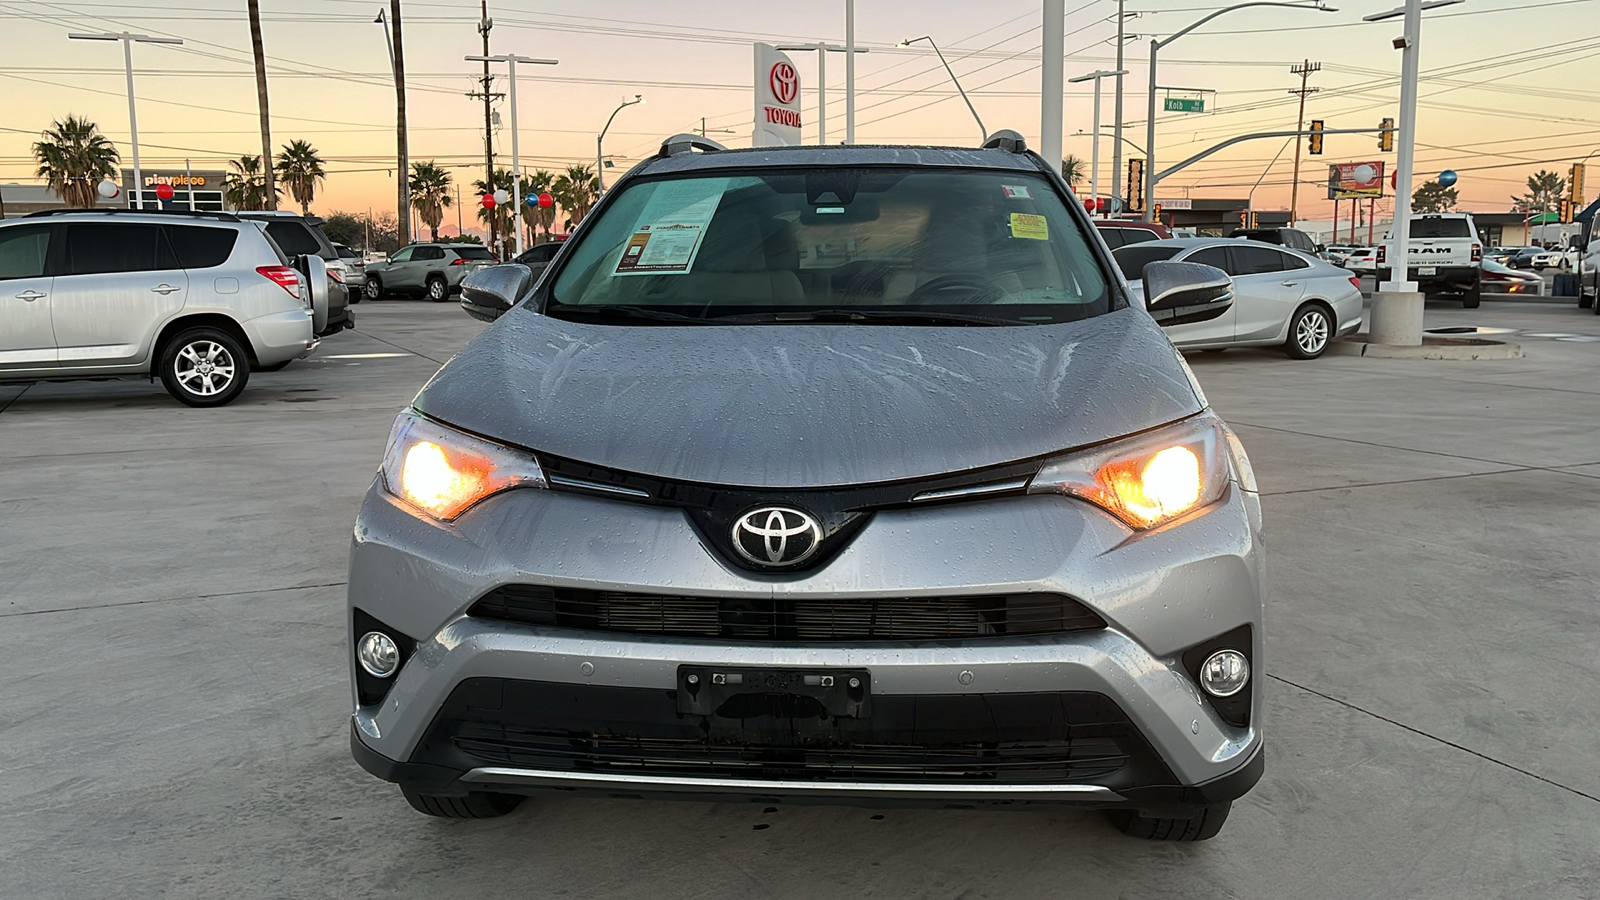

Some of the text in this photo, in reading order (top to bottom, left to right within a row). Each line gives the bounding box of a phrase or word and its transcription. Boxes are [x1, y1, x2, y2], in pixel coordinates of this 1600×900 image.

[1168, 100, 1183, 110] Kolb
[764, 106, 802, 128] TOYOTA
[144, 174, 205, 187] playplace
